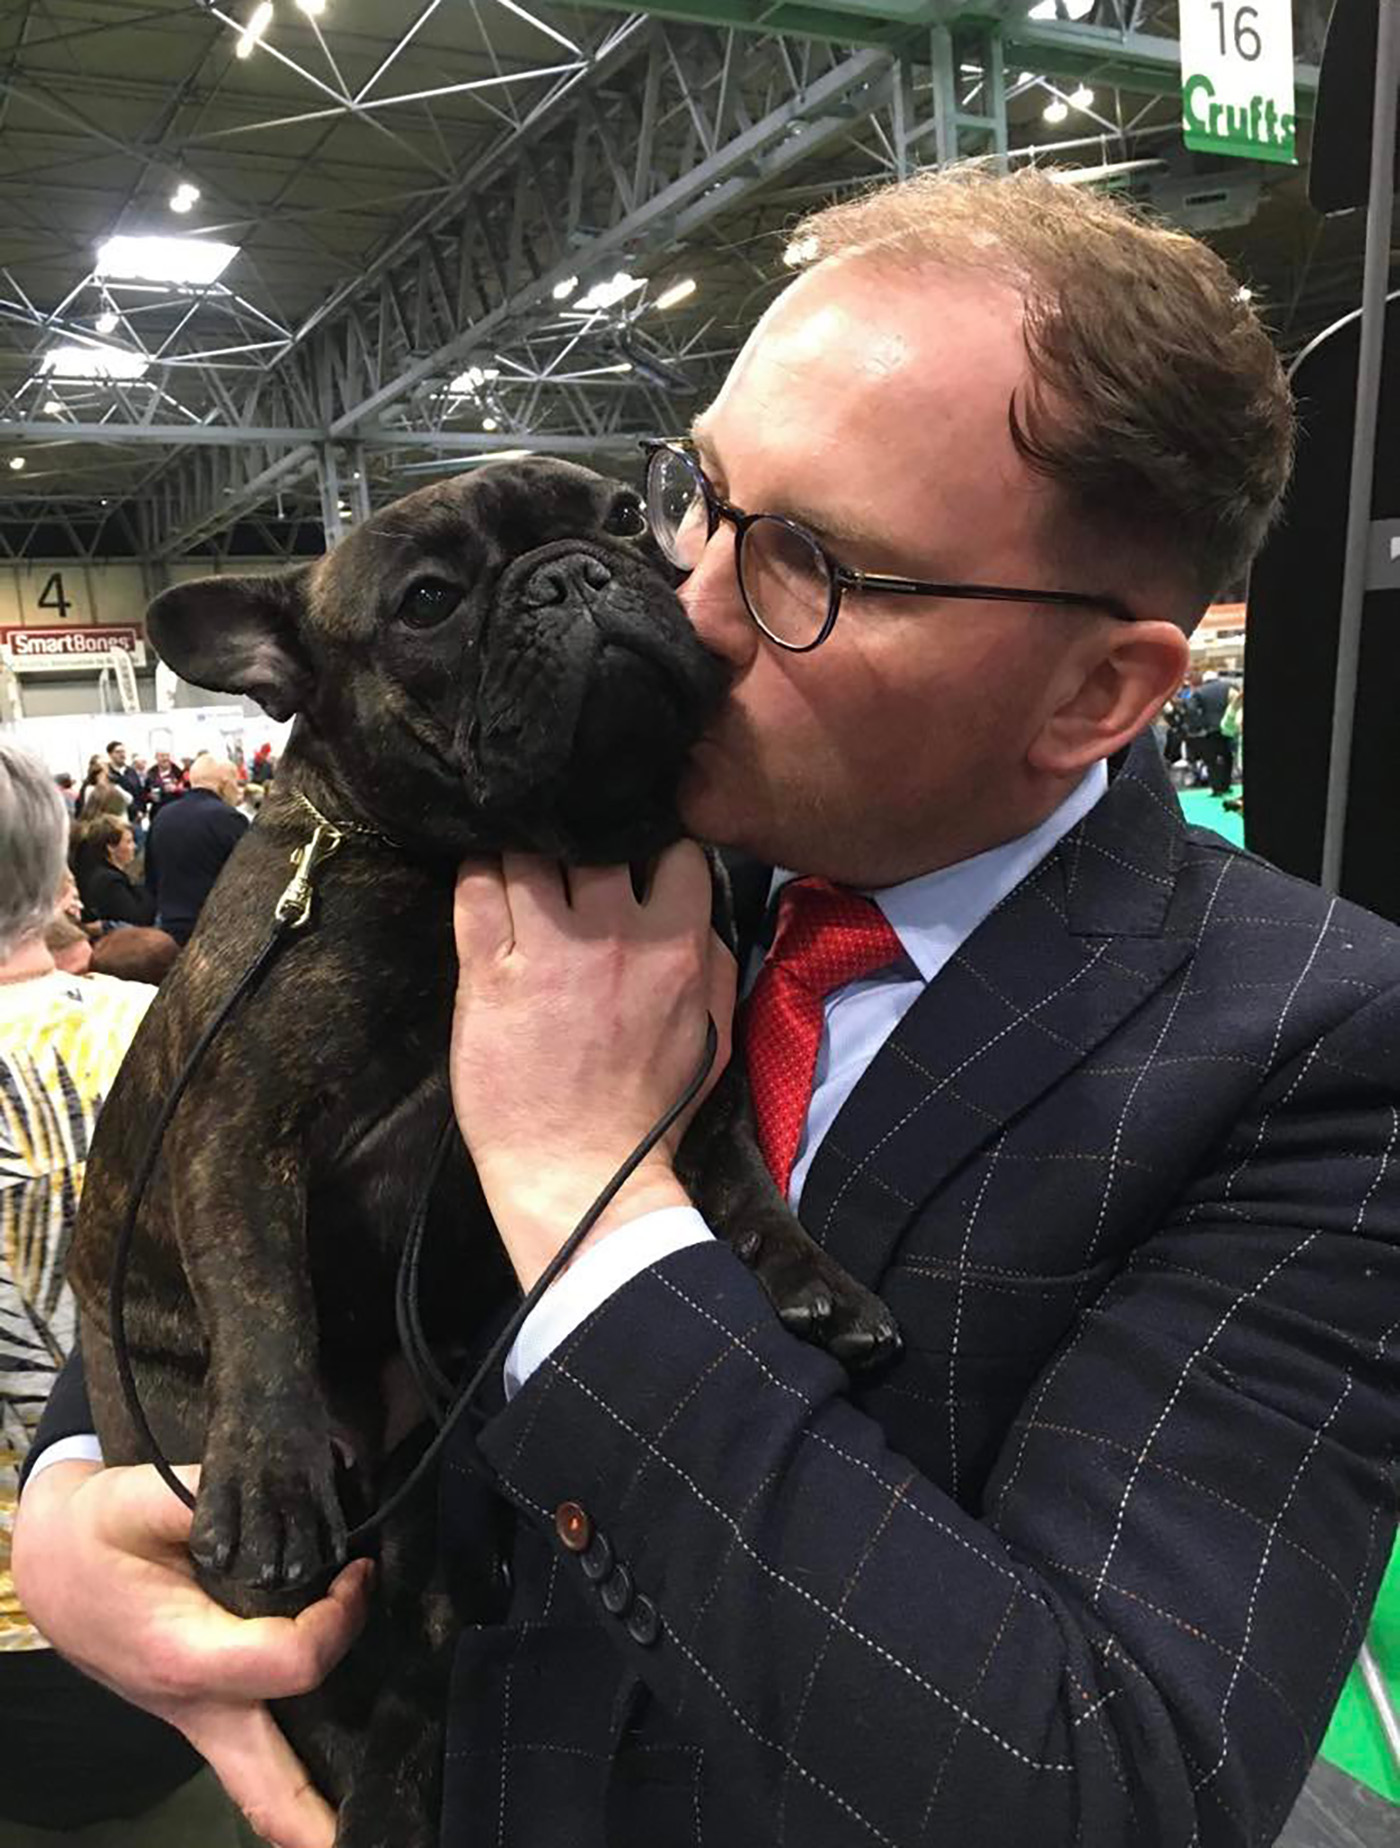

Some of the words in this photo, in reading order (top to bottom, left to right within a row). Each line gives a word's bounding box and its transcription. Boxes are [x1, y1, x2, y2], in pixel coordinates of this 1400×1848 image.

[1211, 1, 1262, 61] 16
[1183, 74, 1296, 144] Crufts
[37, 572, 72, 618] 4
[15, 633, 130, 654] SmartBones
